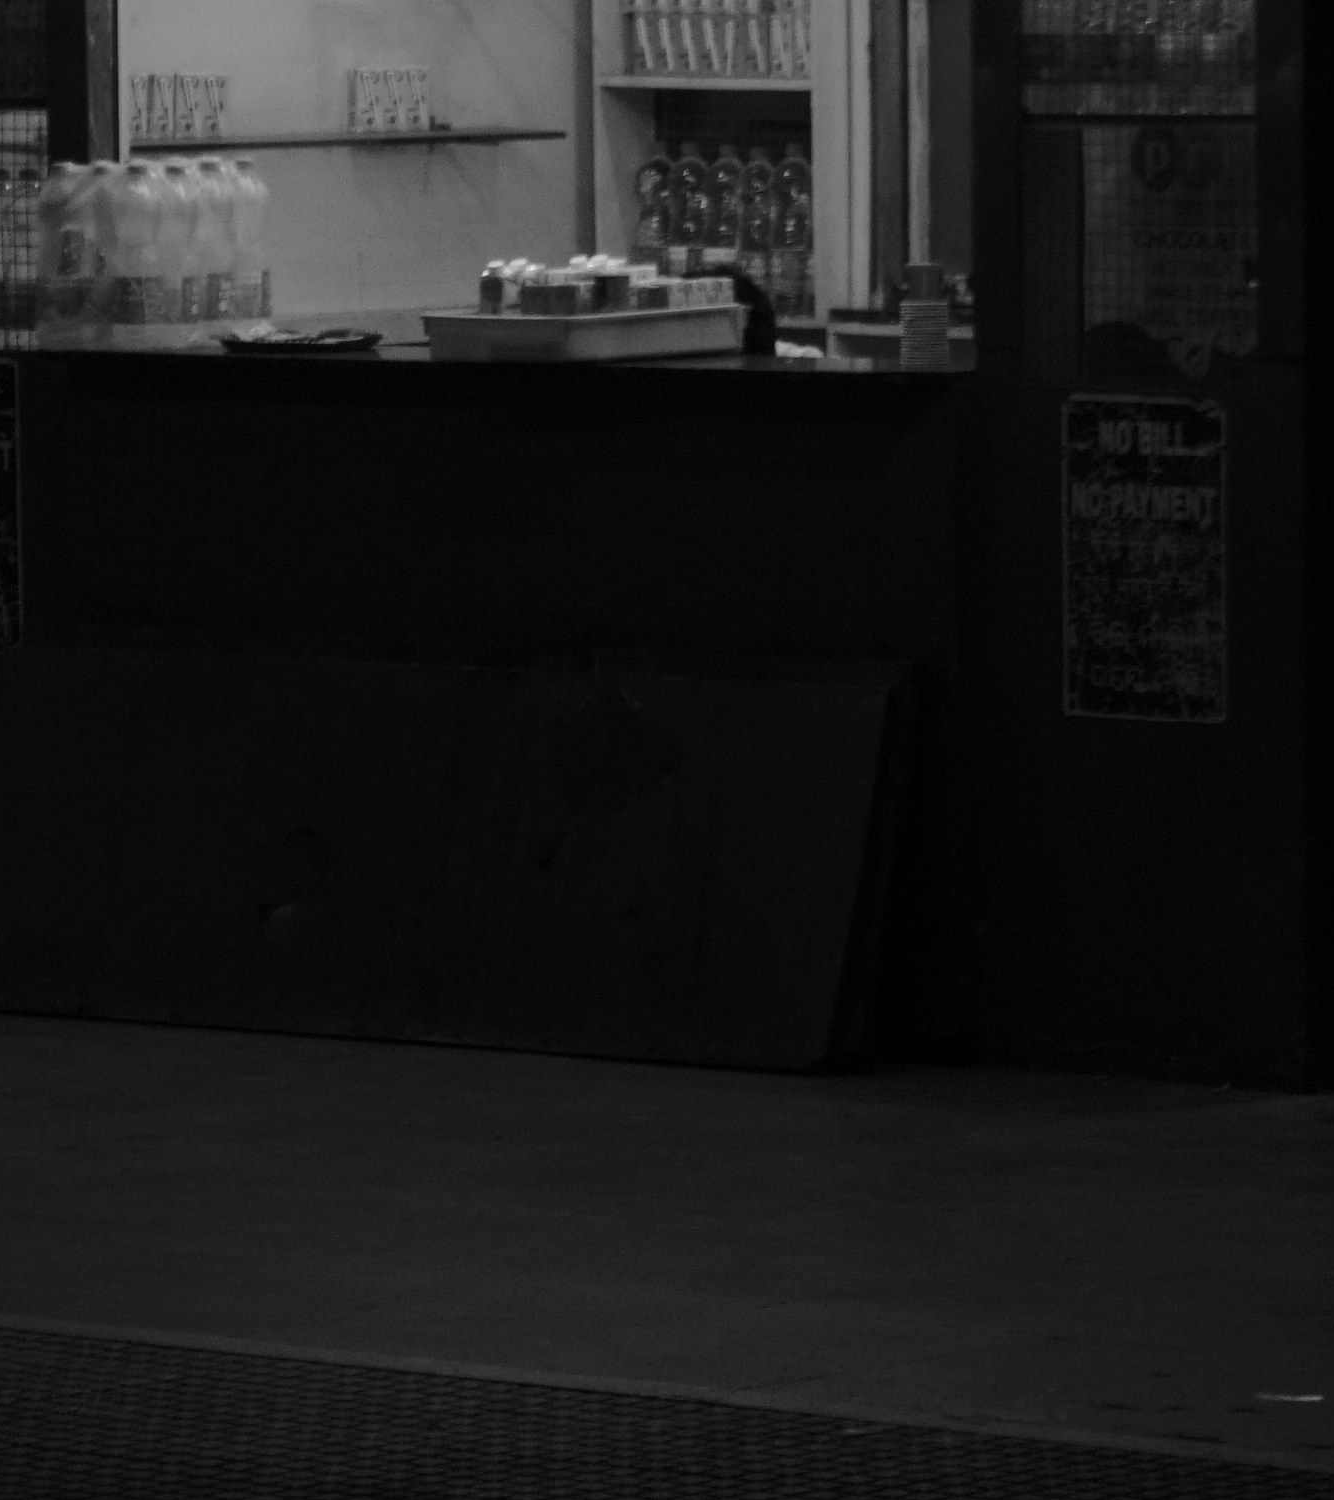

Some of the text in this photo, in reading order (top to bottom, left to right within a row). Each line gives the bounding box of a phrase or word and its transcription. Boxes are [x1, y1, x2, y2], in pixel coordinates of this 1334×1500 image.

[1098, 420, 1186, 456] NO BILL
[1071, 482, 1217, 523] NO PAYMENT
